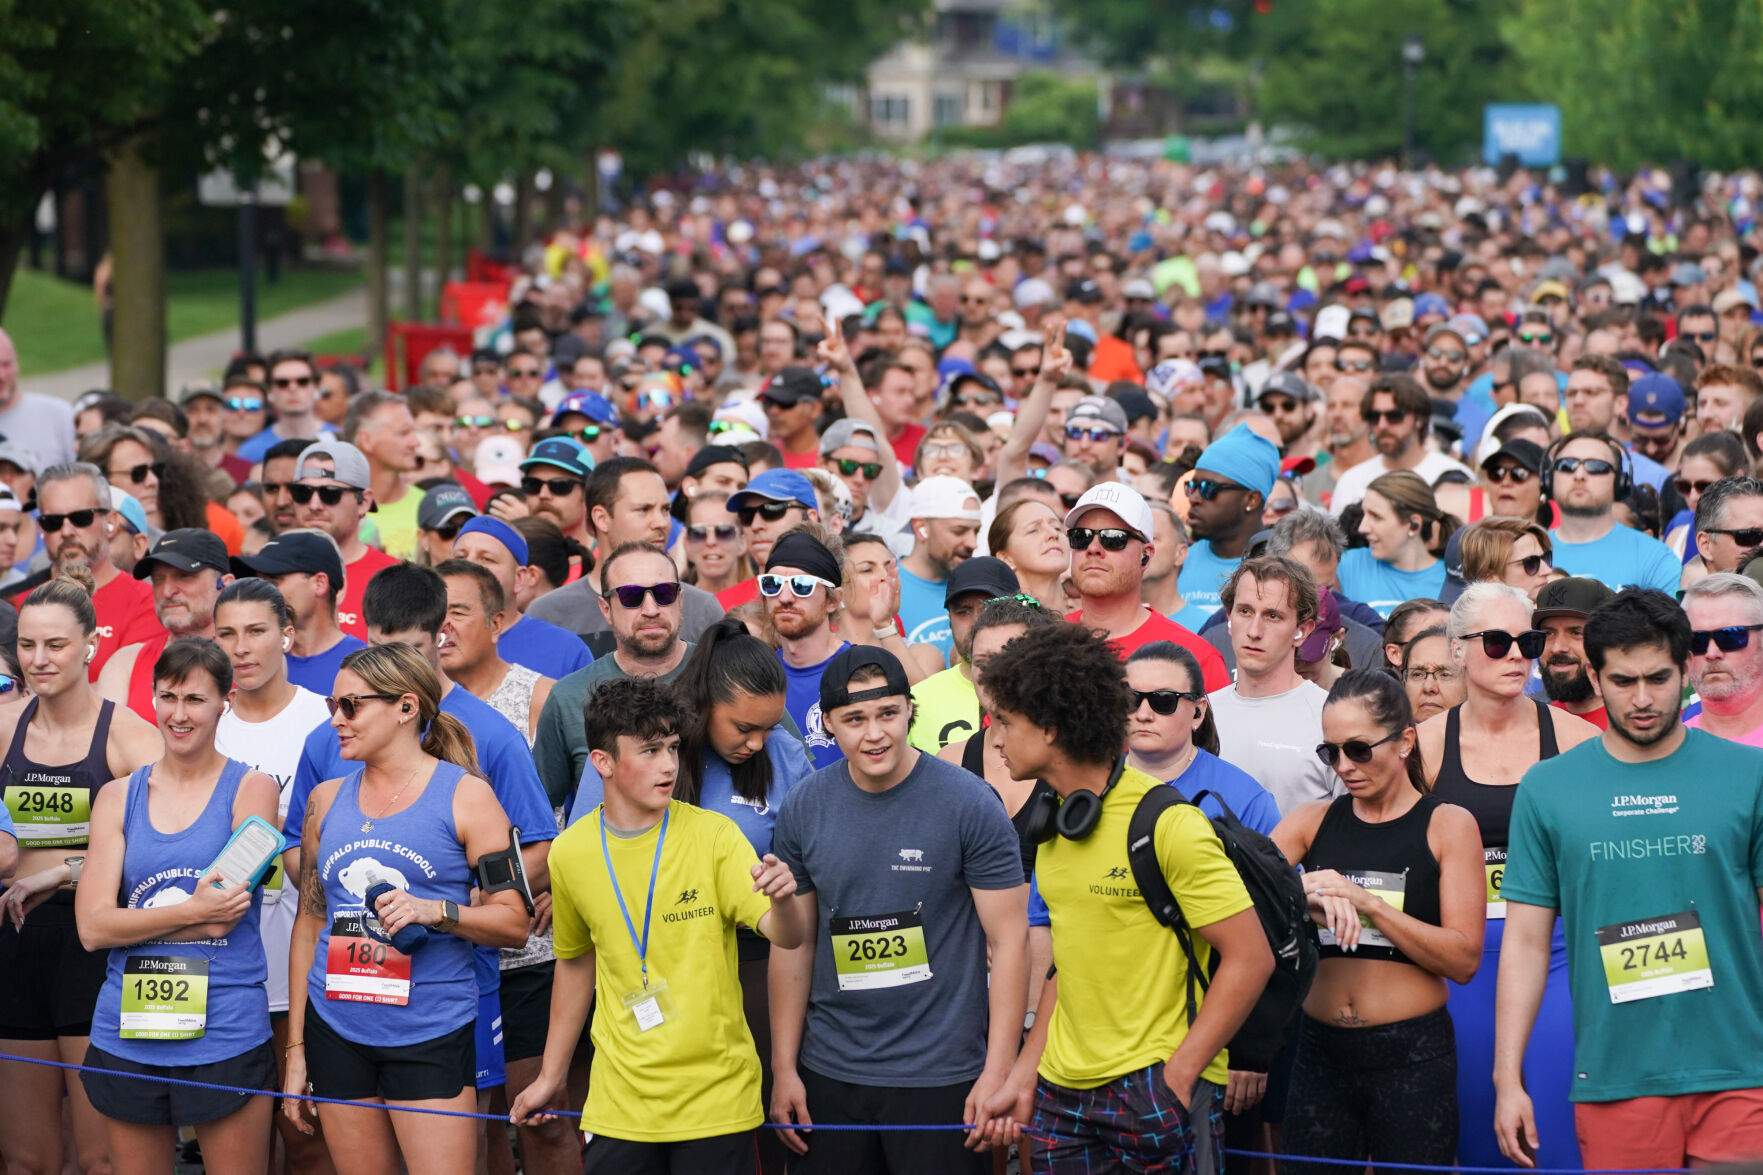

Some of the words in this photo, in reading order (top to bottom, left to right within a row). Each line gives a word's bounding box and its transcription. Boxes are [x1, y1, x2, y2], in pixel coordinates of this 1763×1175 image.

[24, 773, 71, 785] J.P.Morgan
[18, 791, 74, 813] 2948
[1611, 794, 1678, 807] J.P.Morgan
[72, 836, 87, 844] SHIRT
[1590, 836, 1692, 861] FINISHER
[322, 843, 353, 881] BUFFALO
[353, 839, 393, 851] PUBLIC
[392, 844, 437, 879] SCHOOLS
[127, 876, 157, 909] BUFFALO
[156, 868, 193, 882] PUBLIC
[662, 906, 715, 923] VOLUNTEER
[848, 917, 899, 931] J.P.Morgan
[1620, 920, 1678, 937] J.P.Morgan
[346, 942, 387, 966] 180
[848, 935, 908, 961] 2623
[1620, 938, 1688, 971] 2744
[138, 960, 187, 972] J.P.Morgan
[361, 967, 378, 975] Buffalo
[134, 979, 189, 1002] 1392
[382, 996, 399, 1004] SHIRT
